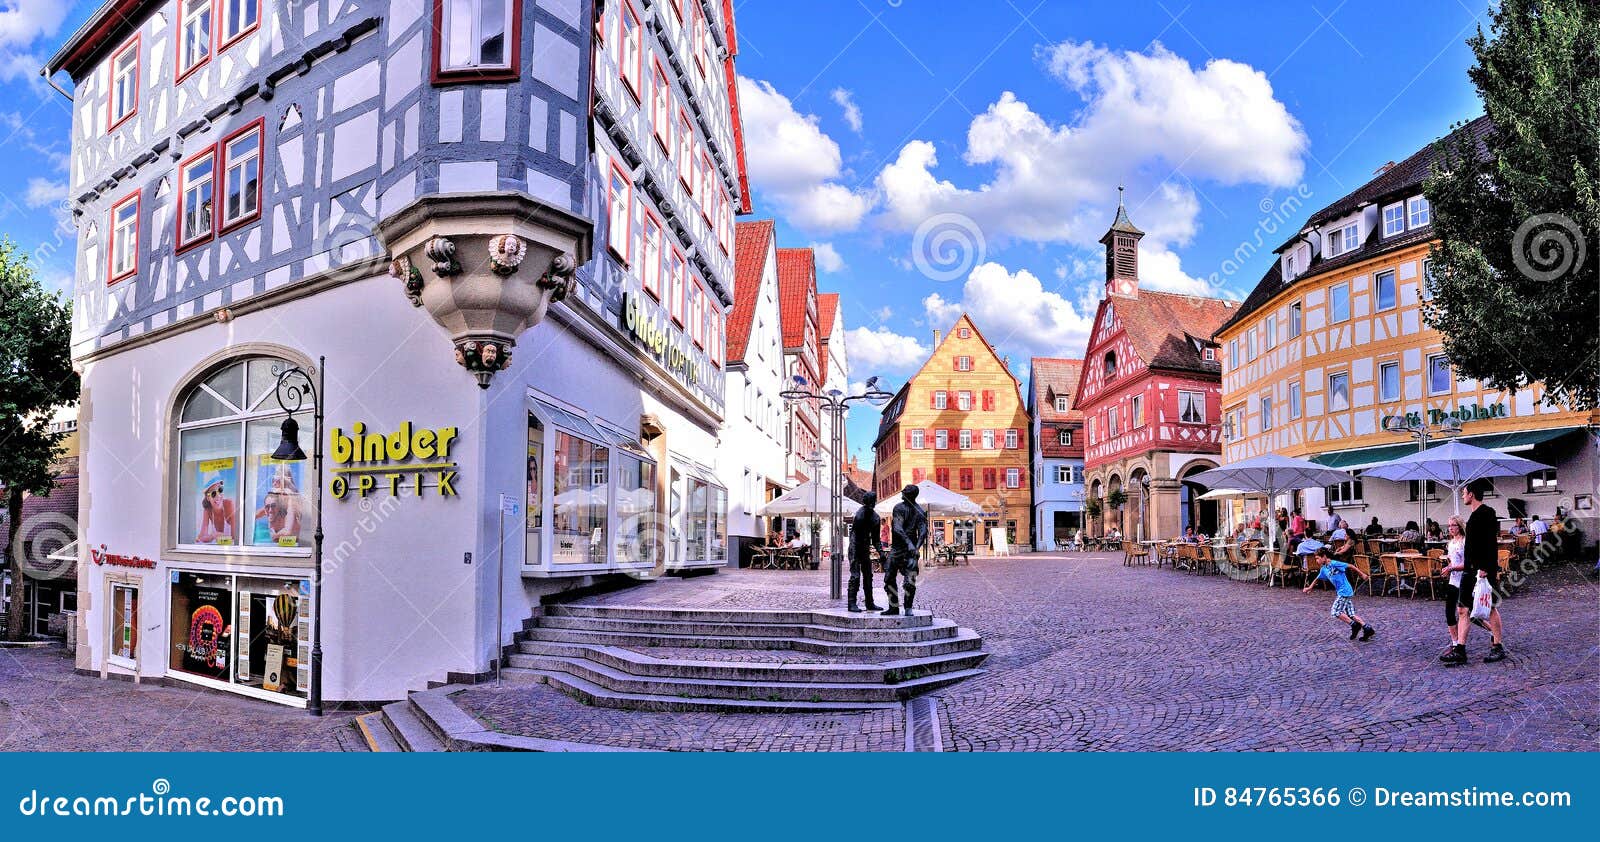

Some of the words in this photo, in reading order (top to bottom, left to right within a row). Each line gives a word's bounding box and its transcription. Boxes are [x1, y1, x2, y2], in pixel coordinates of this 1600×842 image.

[623, 290, 668, 354] binder
[1381, 412, 1421, 430] Cfé
[331, 421, 458, 464] binder
[330, 471, 457, 499] OPTIK
